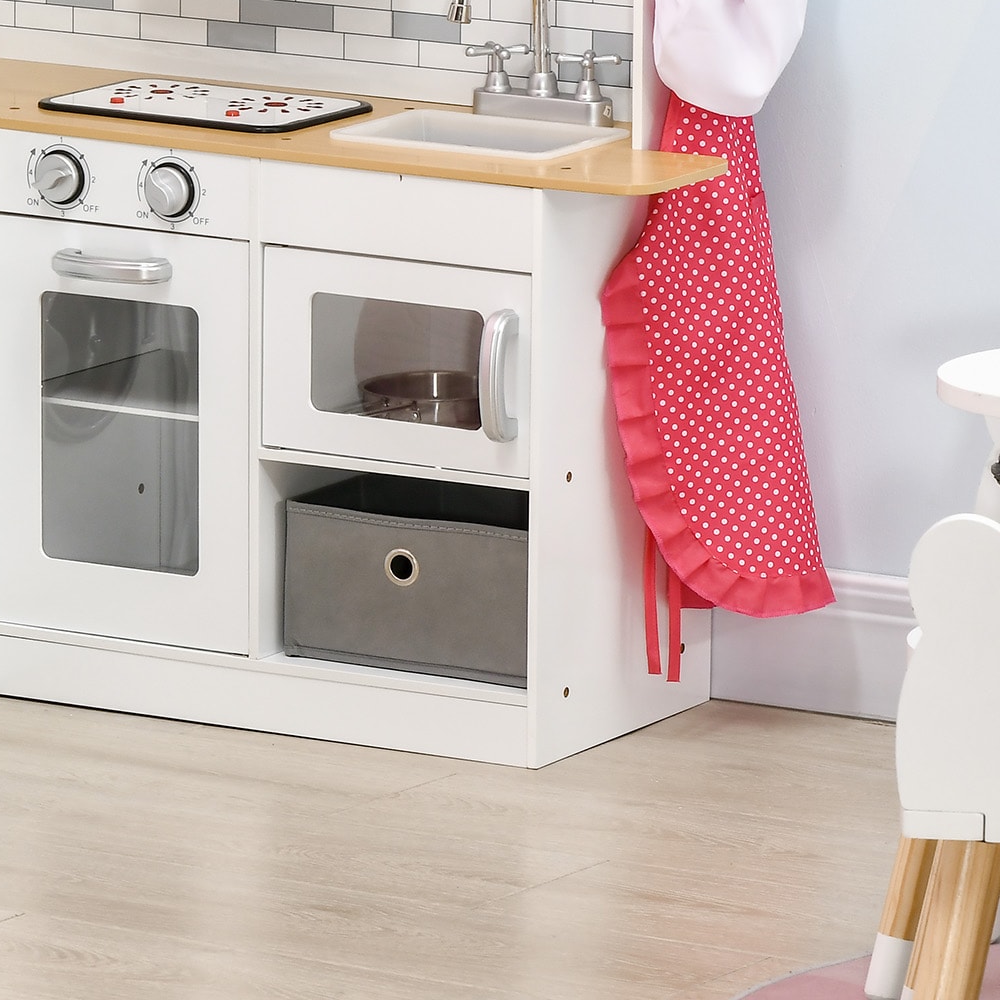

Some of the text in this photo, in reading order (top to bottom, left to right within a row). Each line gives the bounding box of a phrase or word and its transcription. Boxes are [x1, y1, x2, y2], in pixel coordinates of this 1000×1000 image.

[202, 188, 207, 196] 2
[26, 197, 39, 206] ON
[82, 204, 100, 213] OFF
[136, 210, 149, 219] ON
[192, 216, 210, 225] OFF
